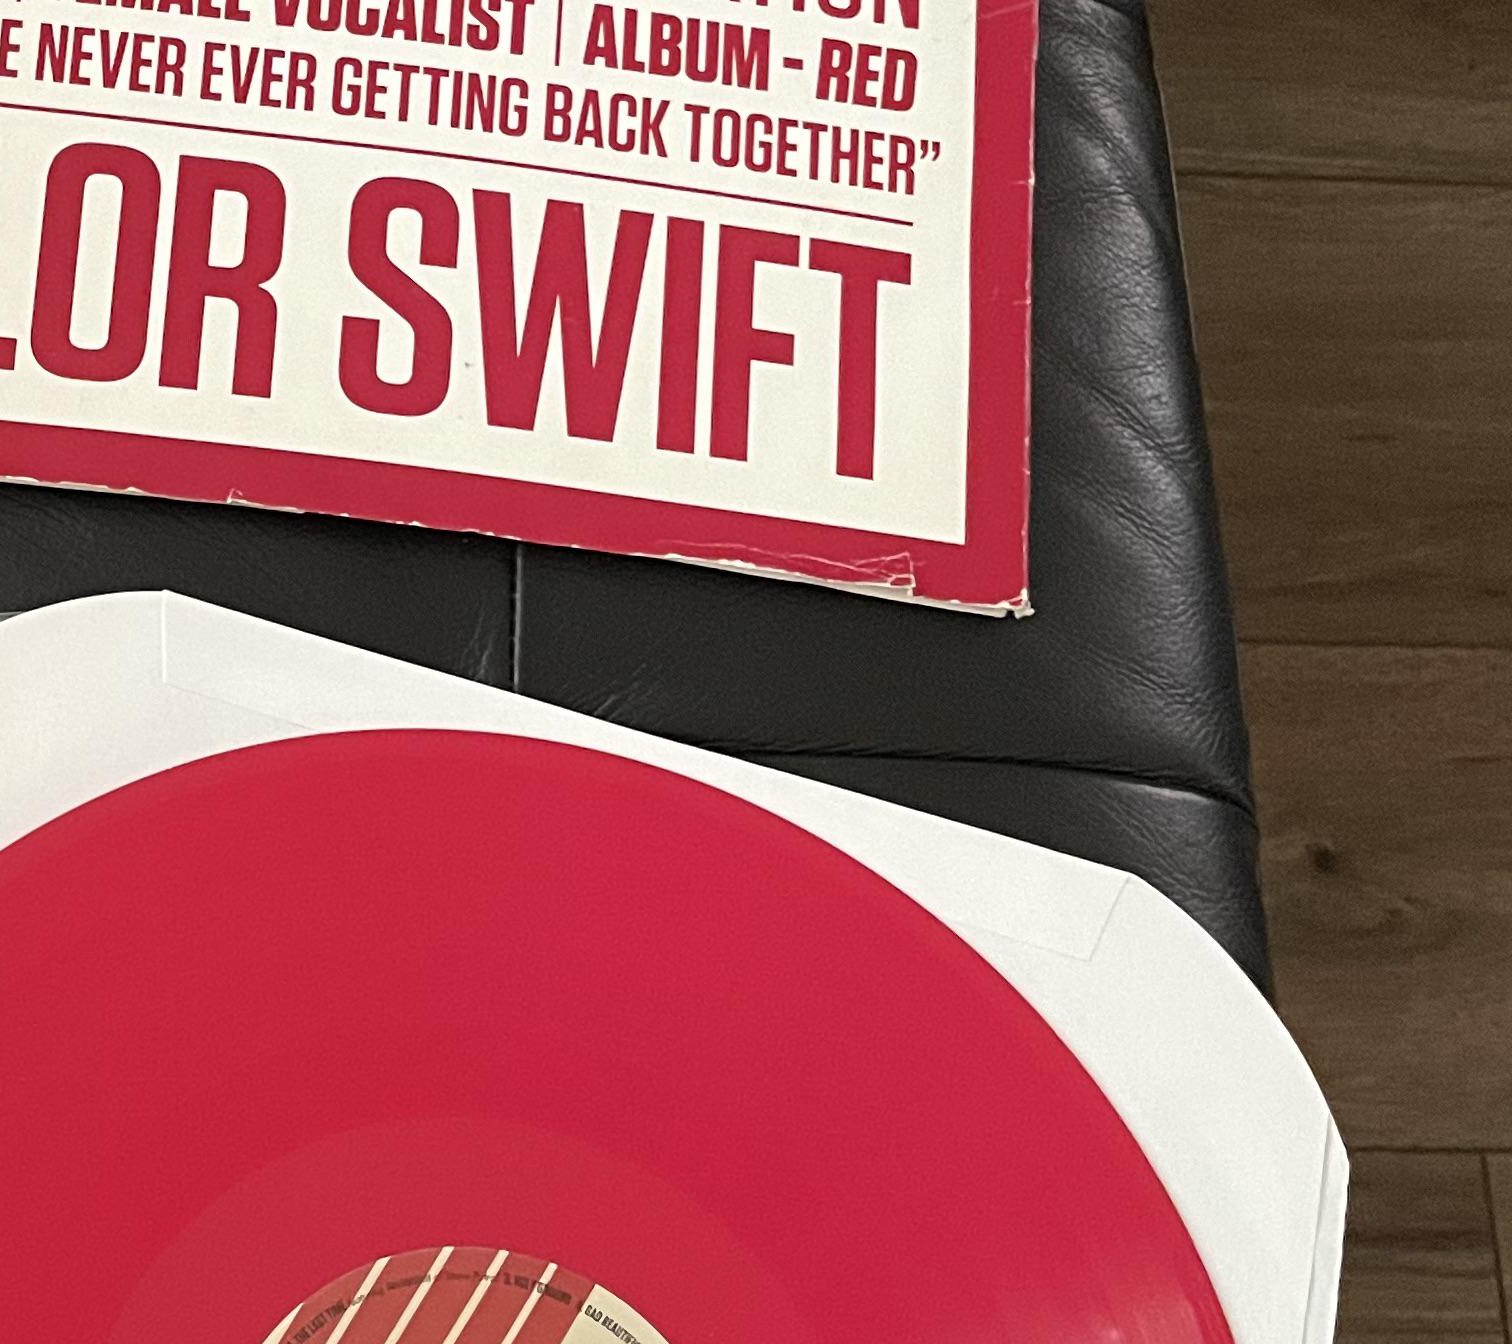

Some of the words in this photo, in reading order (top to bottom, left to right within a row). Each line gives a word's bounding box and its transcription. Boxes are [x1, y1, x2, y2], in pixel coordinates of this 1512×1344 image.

[36, 23, 186, 96] NEVER
[200, 42, 316, 111] EVER
[332, 57, 528, 136] GETTING
[544, 83, 670, 157] BACK
[685, 104, 940, 195] TOGETHER”
[584, 4, 770, 91] ALBUM
[816, 38, 917, 111] RED
[339, 177, 911, 480] SWIFT
